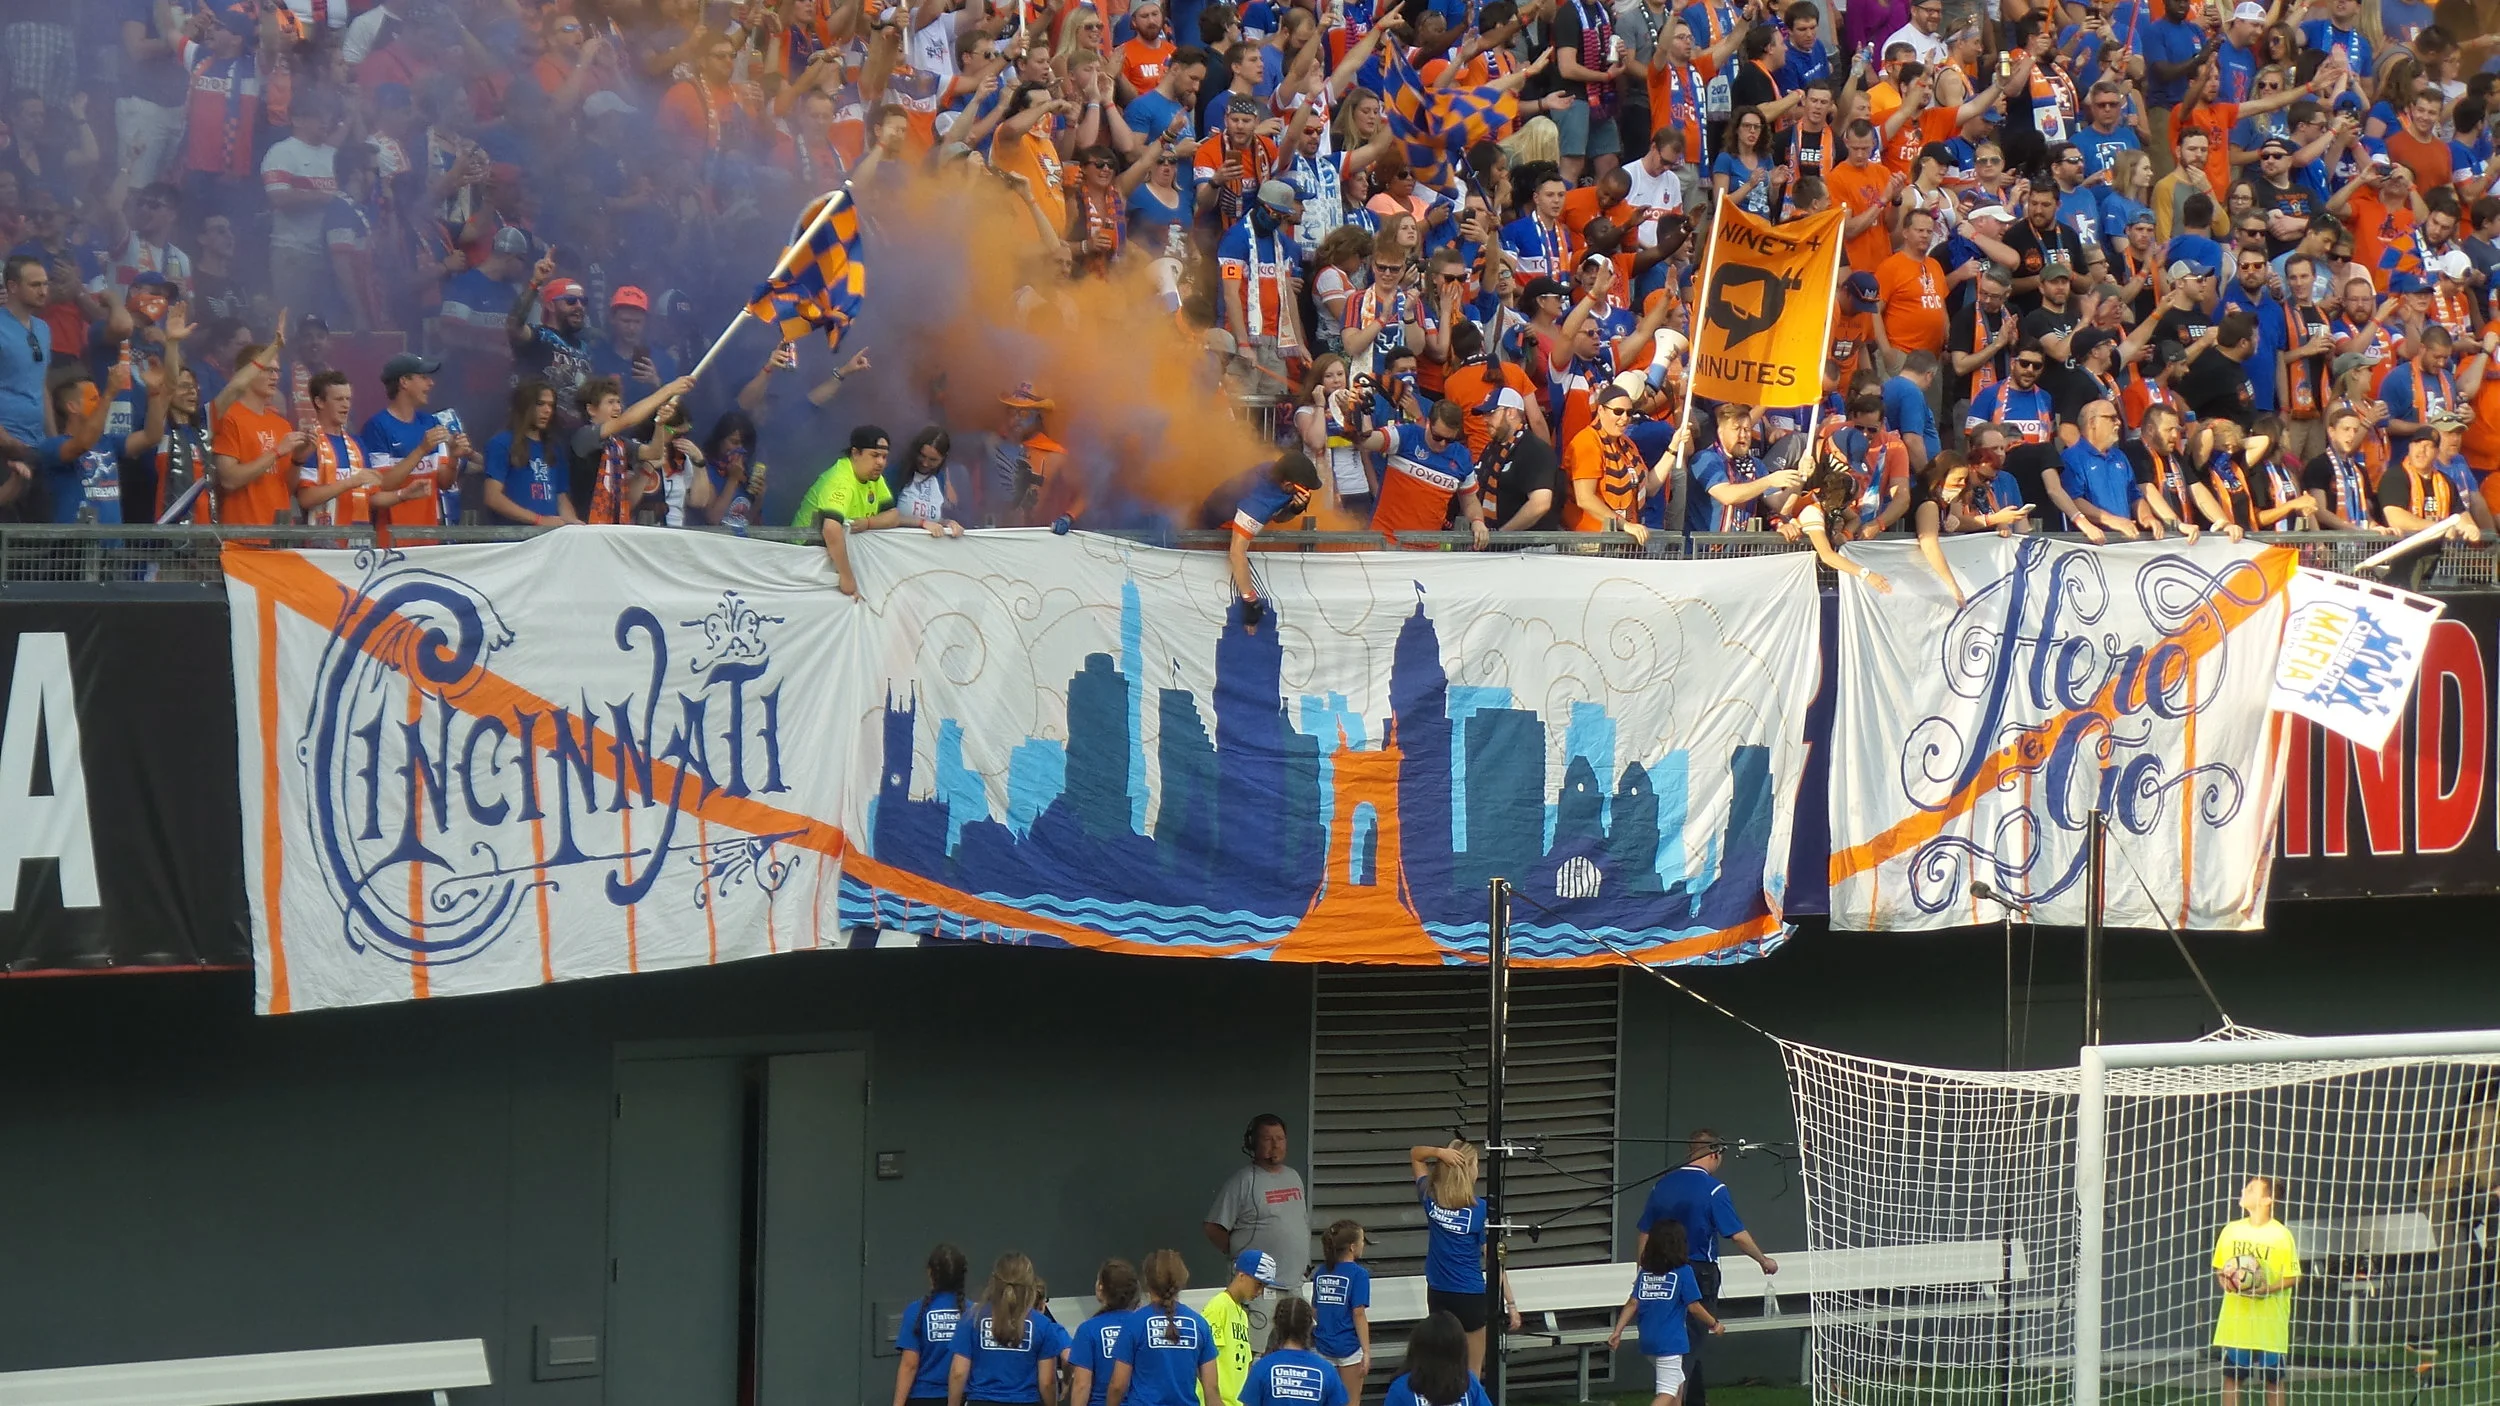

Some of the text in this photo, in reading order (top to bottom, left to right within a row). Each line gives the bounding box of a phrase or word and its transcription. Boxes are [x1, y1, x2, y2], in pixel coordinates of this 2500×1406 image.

[1801, 152, 1820, 161] BEE
[2189, 328, 2208, 338] BEE
[1409, 463, 1455, 489] TOYOTA
[2283, 607, 2349, 680] MAFIA
[304, 572, 800, 958] CINCINNATI
[2232, 1240, 2277, 1260] BB&T
[931, 1322, 956, 1330] Dairy
[931, 1331, 955, 1339] Farm
[1275, 1368, 1308, 1378] United
[1275, 1378, 1303, 1387] Dairy
[1275, 1387, 1314, 1397] Farmers
